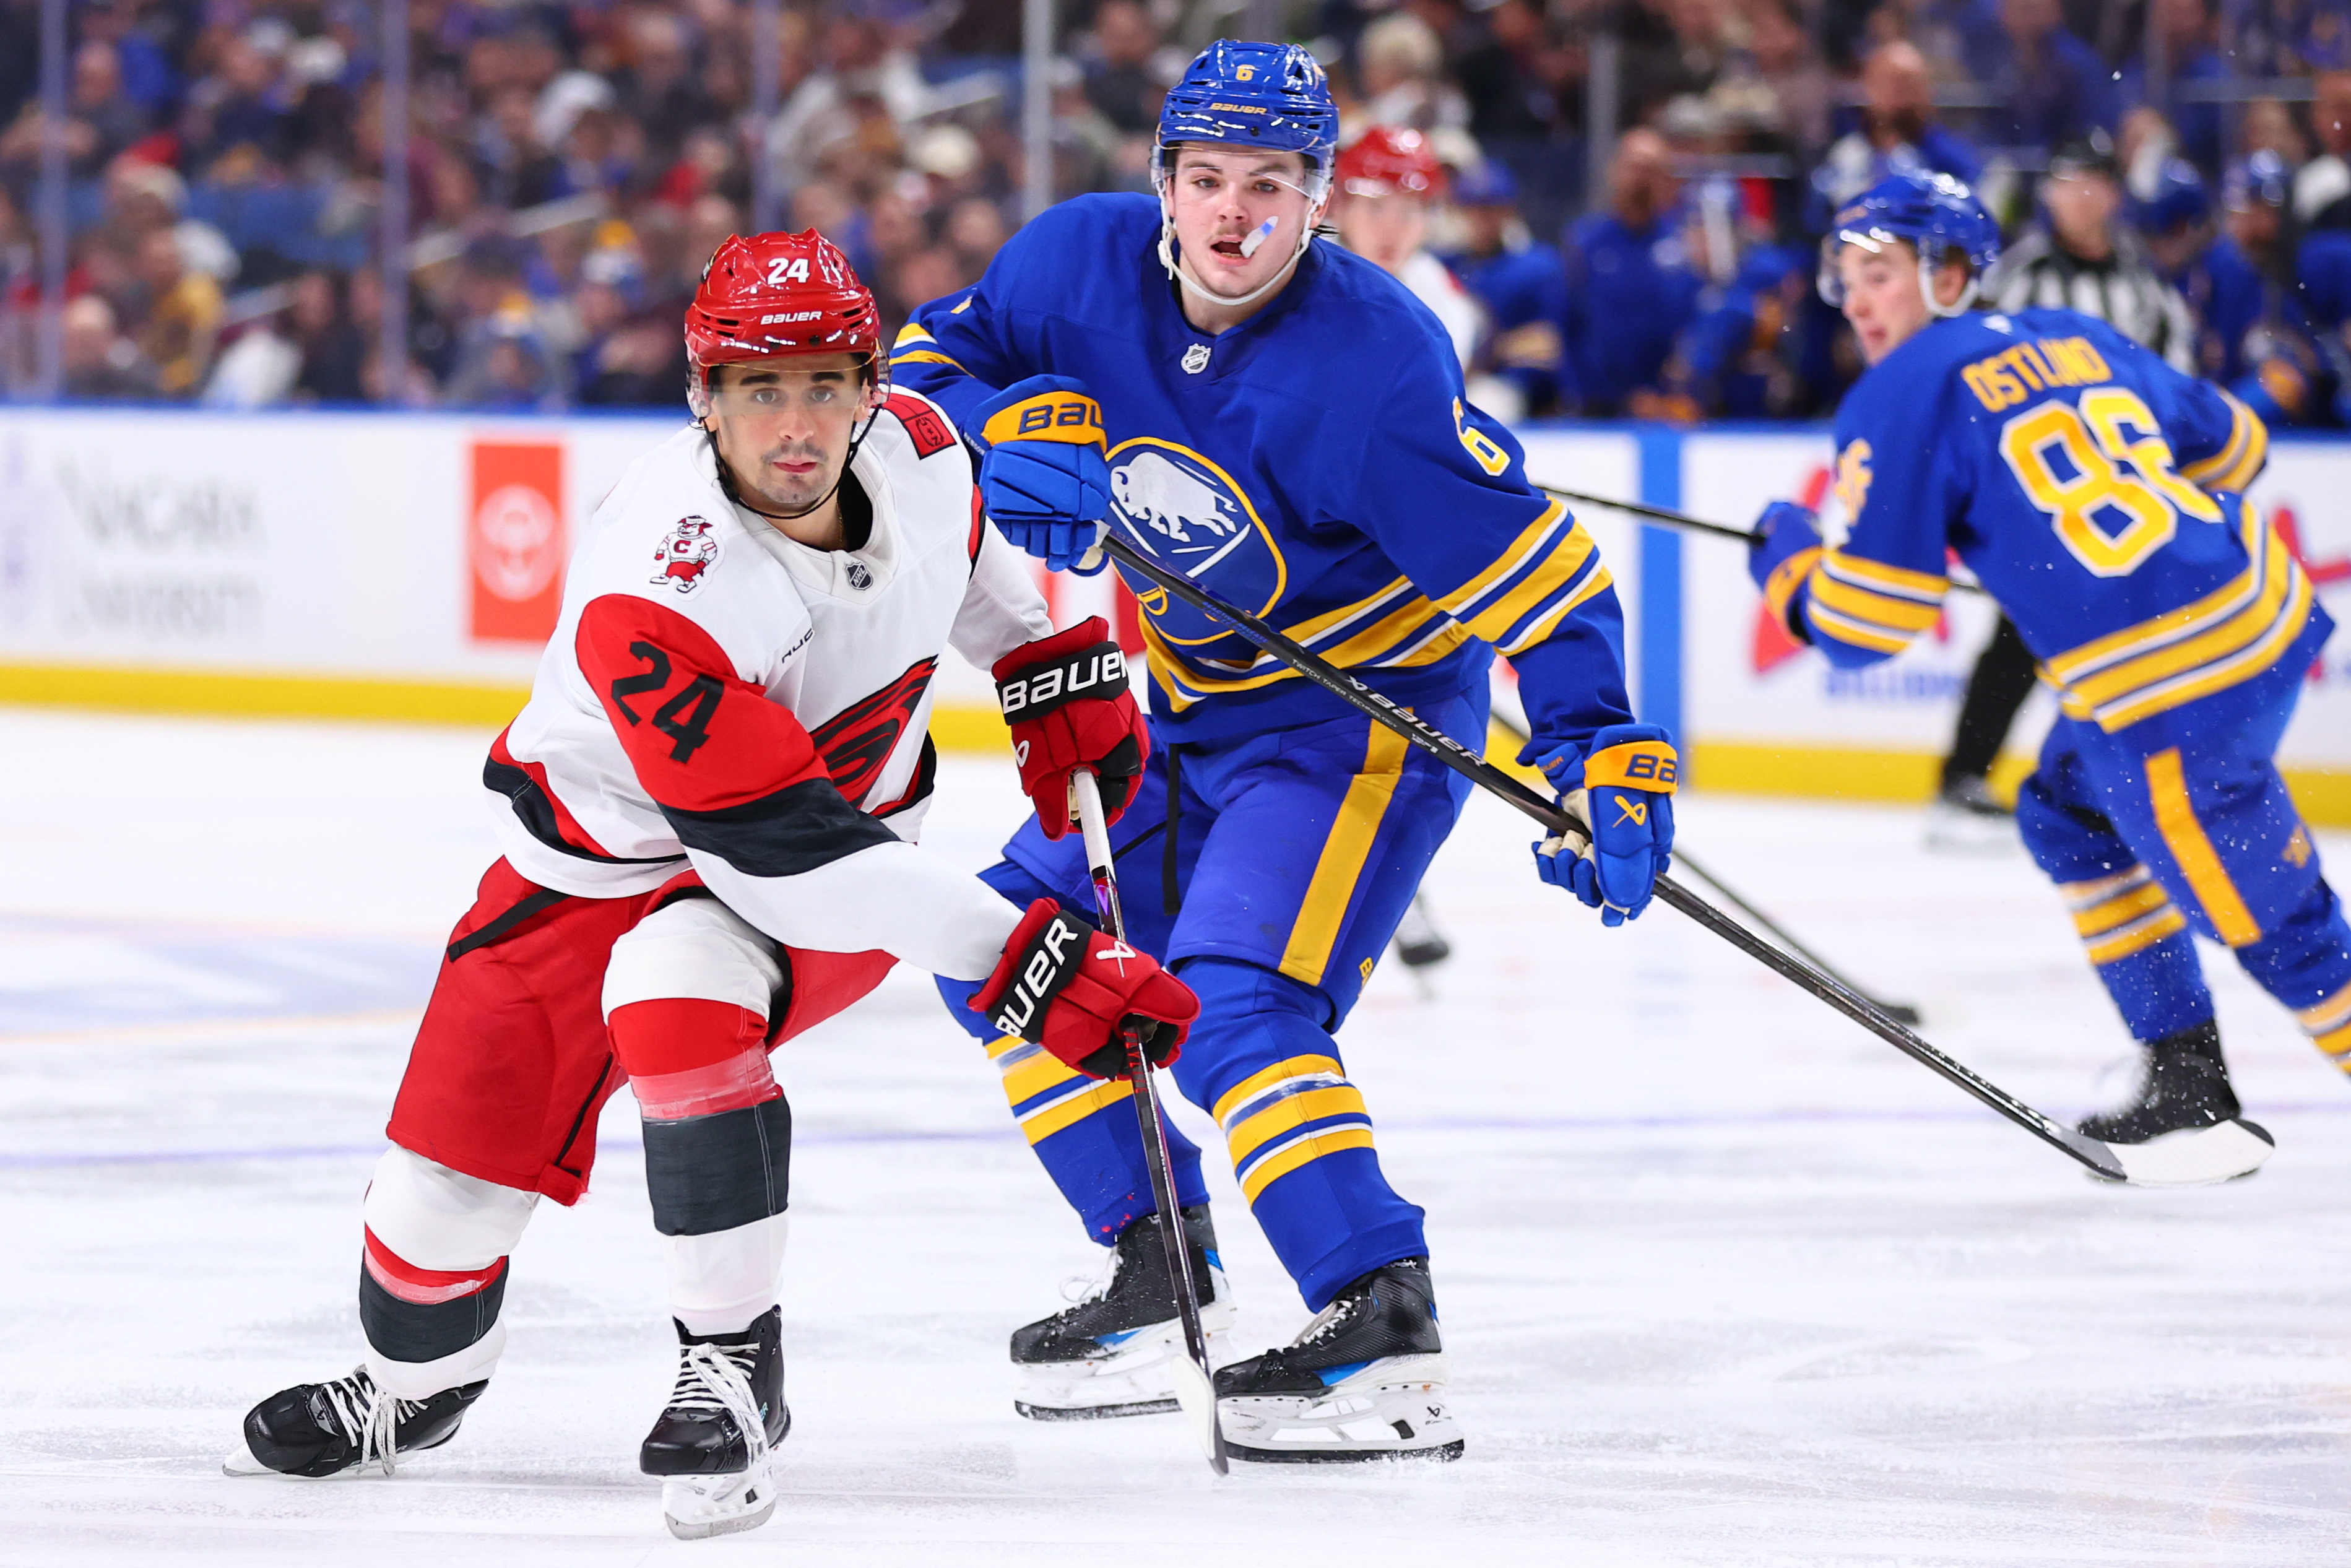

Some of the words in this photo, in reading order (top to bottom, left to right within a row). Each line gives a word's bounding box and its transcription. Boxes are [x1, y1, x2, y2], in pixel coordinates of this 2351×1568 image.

[1236, 64, 1255, 81] 6
[1210, 102, 1268, 115] BAUER
[767, 258, 810, 285] 24
[760, 310, 823, 326] BAUER
[1452, 395, 1511, 477] 6
[1998, 386, 2225, 578] 86
[673, 539, 691, 553] C
[1322, 678, 1347, 696] TAPER
[611, 641, 724, 764] 24
[1367, 692, 1487, 767] BAUER
